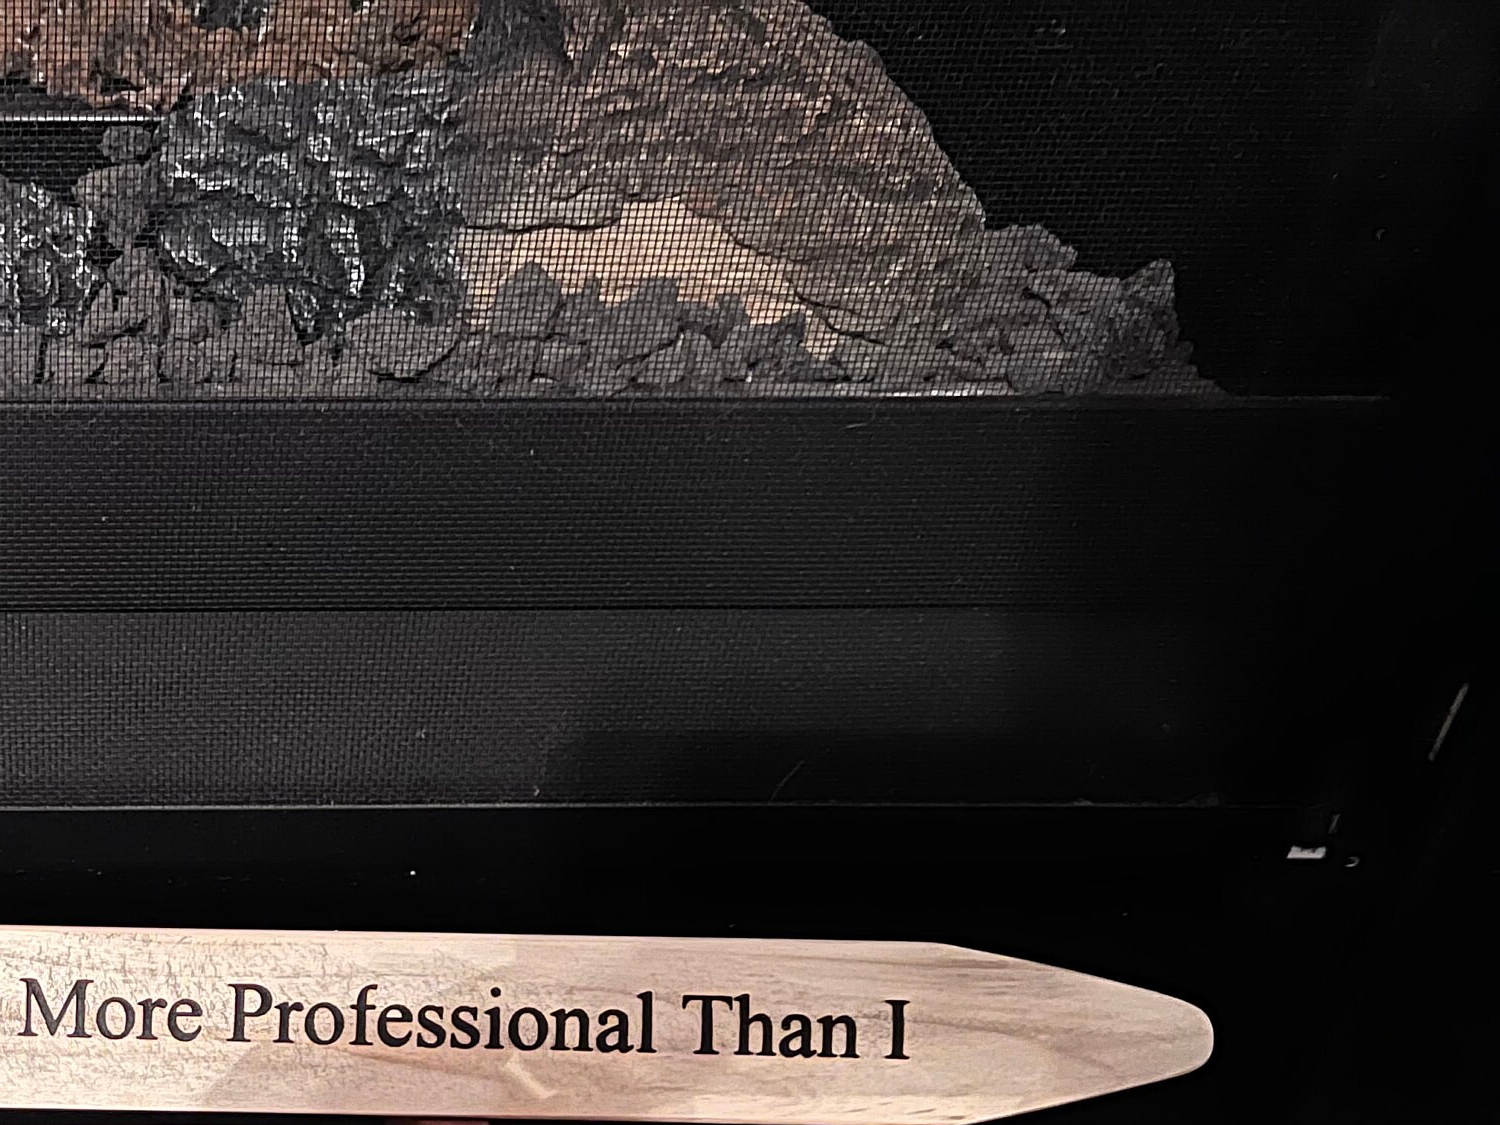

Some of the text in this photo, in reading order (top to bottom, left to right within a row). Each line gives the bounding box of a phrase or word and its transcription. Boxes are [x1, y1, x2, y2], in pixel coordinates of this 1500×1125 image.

[17, 977, 202, 1041] More
[226, 983, 658, 1055] Professional
[681, 993, 859, 1059] Than
[883, 999, 912, 1060] I
